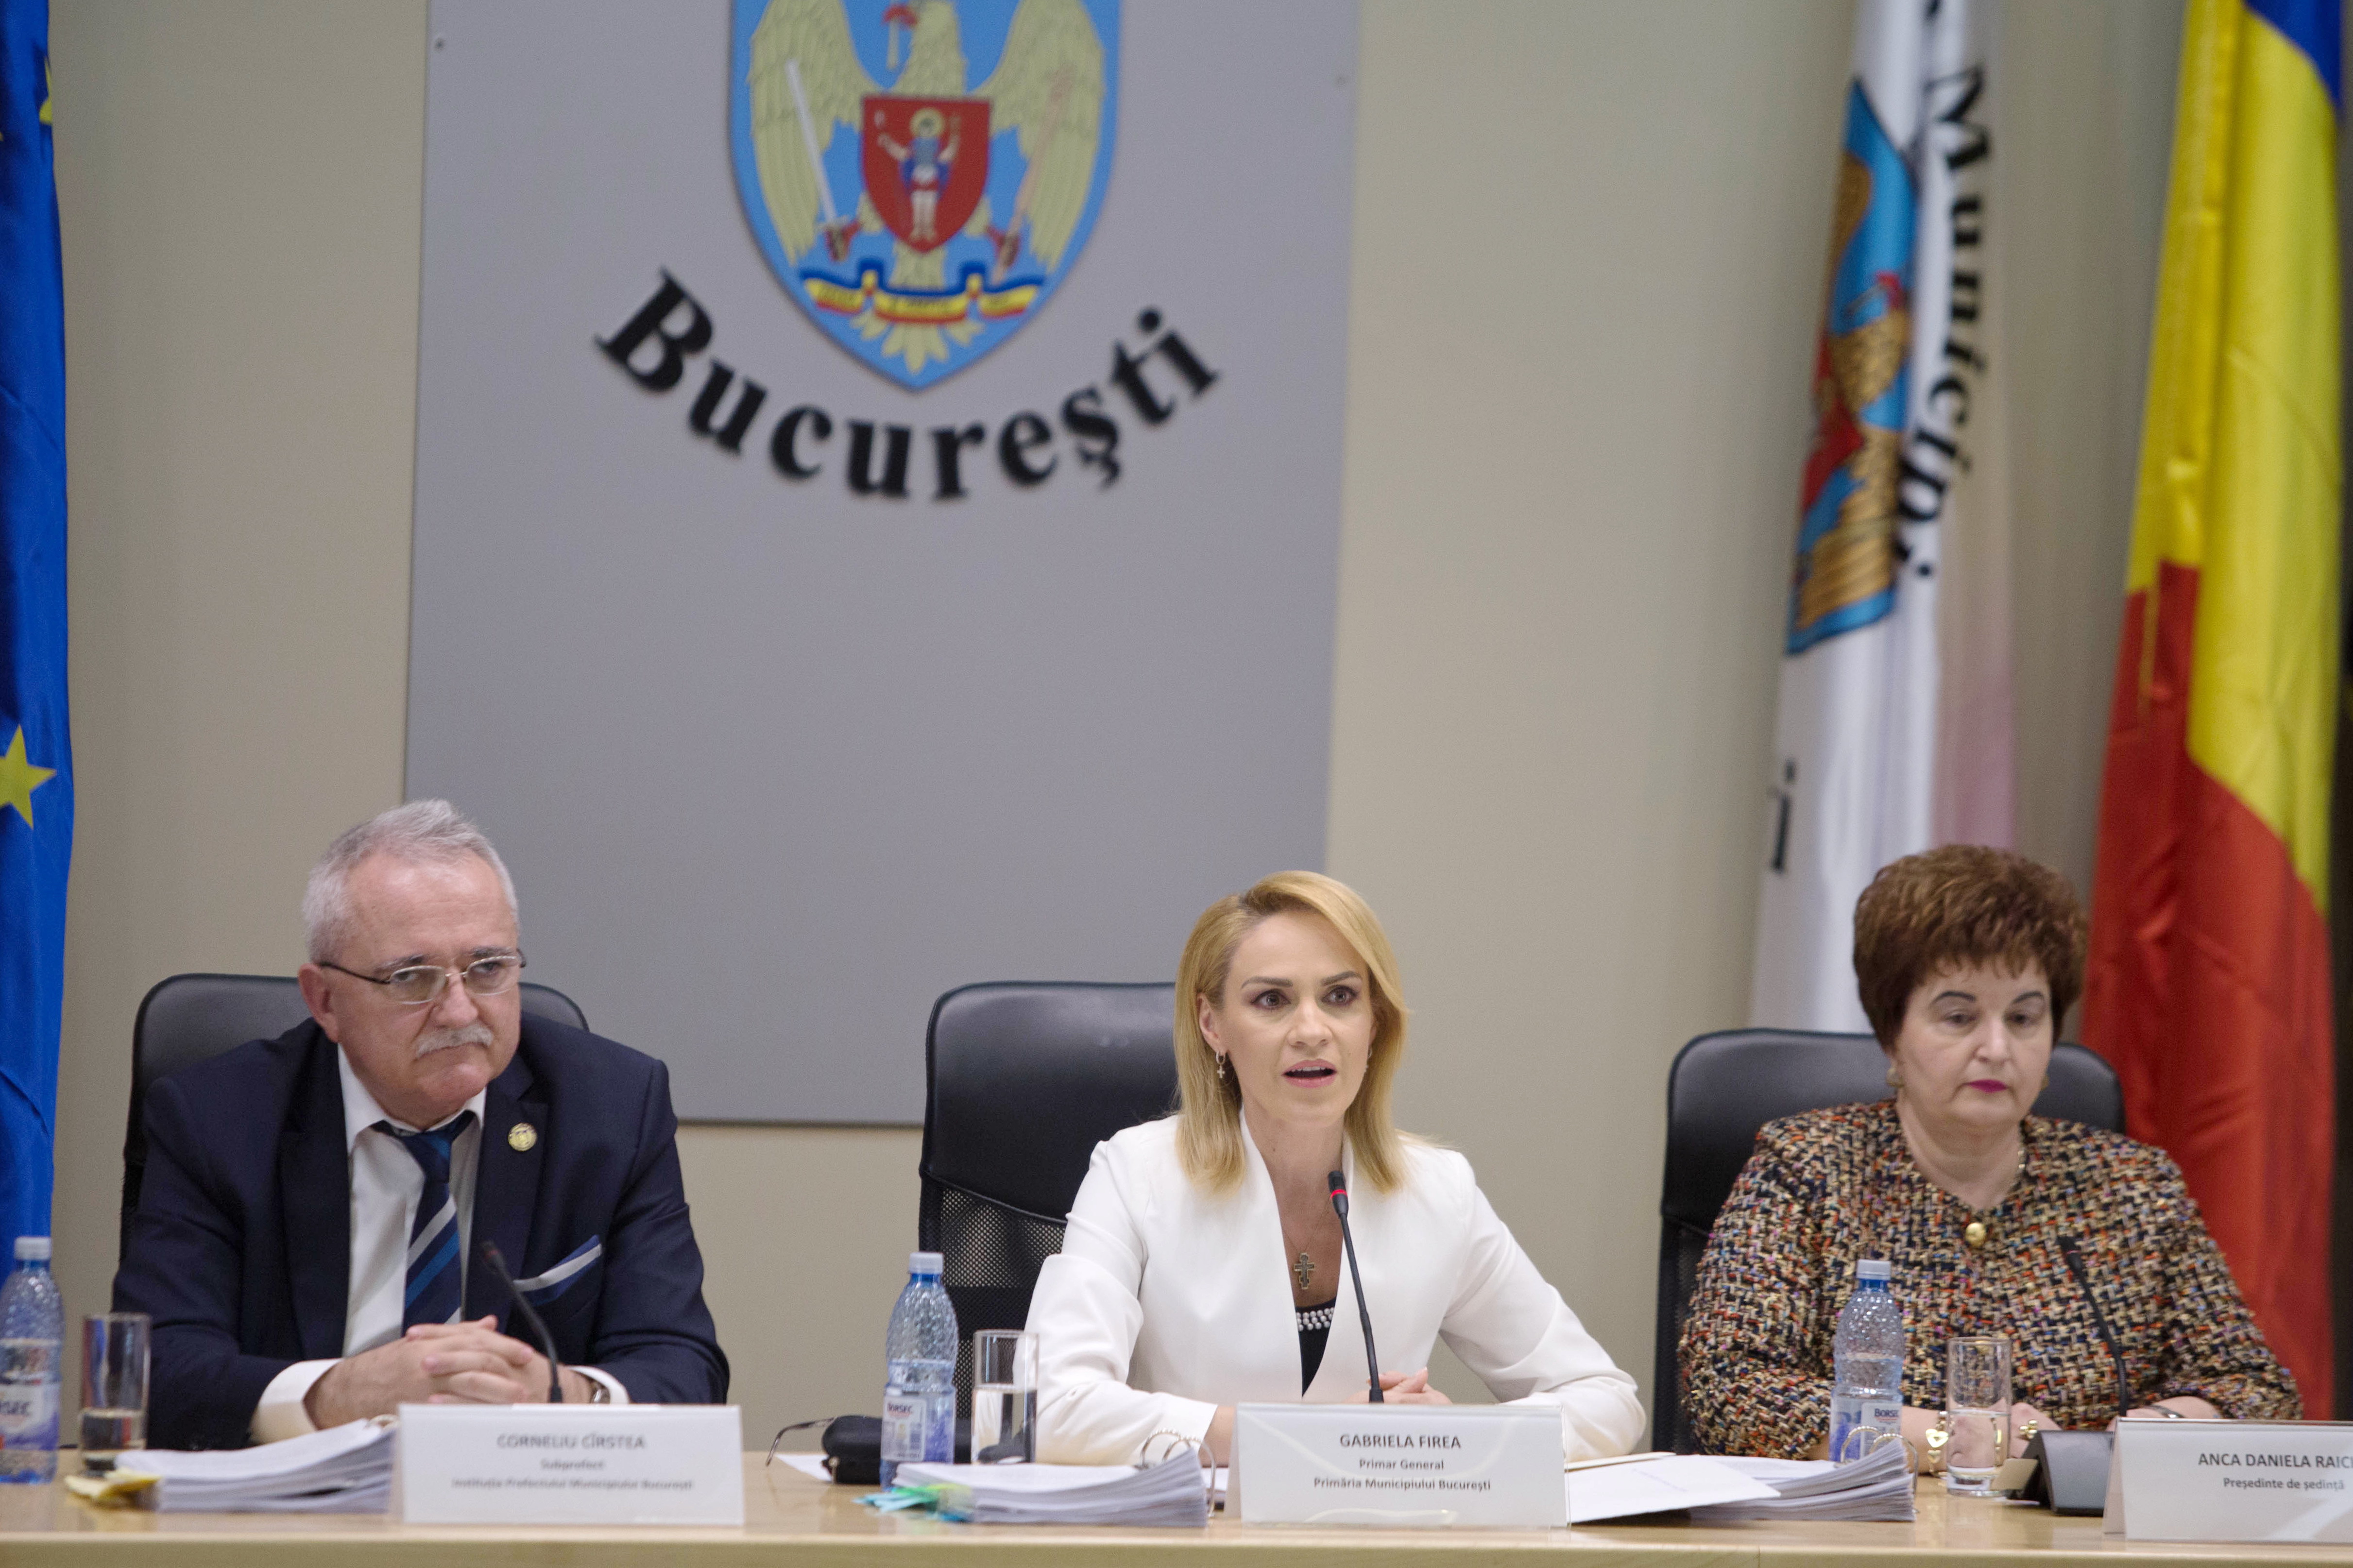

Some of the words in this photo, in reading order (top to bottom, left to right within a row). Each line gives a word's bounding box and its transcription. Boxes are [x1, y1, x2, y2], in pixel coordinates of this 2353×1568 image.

[496, 1434, 577, 1449] CORNELIU
[1340, 1434, 1414, 1448] GABRIELA
[1419, 1435, 1461, 1449] FIREA
[1359, 1459, 1397, 1469] Primar
[1400, 1459, 1444, 1470] General
[2198, 1453, 2241, 1466] ANCA
[2246, 1454, 2311, 1467] DANIELA
[2315, 1455, 2353, 1468] RAIC
[1314, 1477, 1361, 1488] Primăria
[1365, 1478, 1435, 1491] Municipiului
[2286, 1478, 2301, 1489] de
